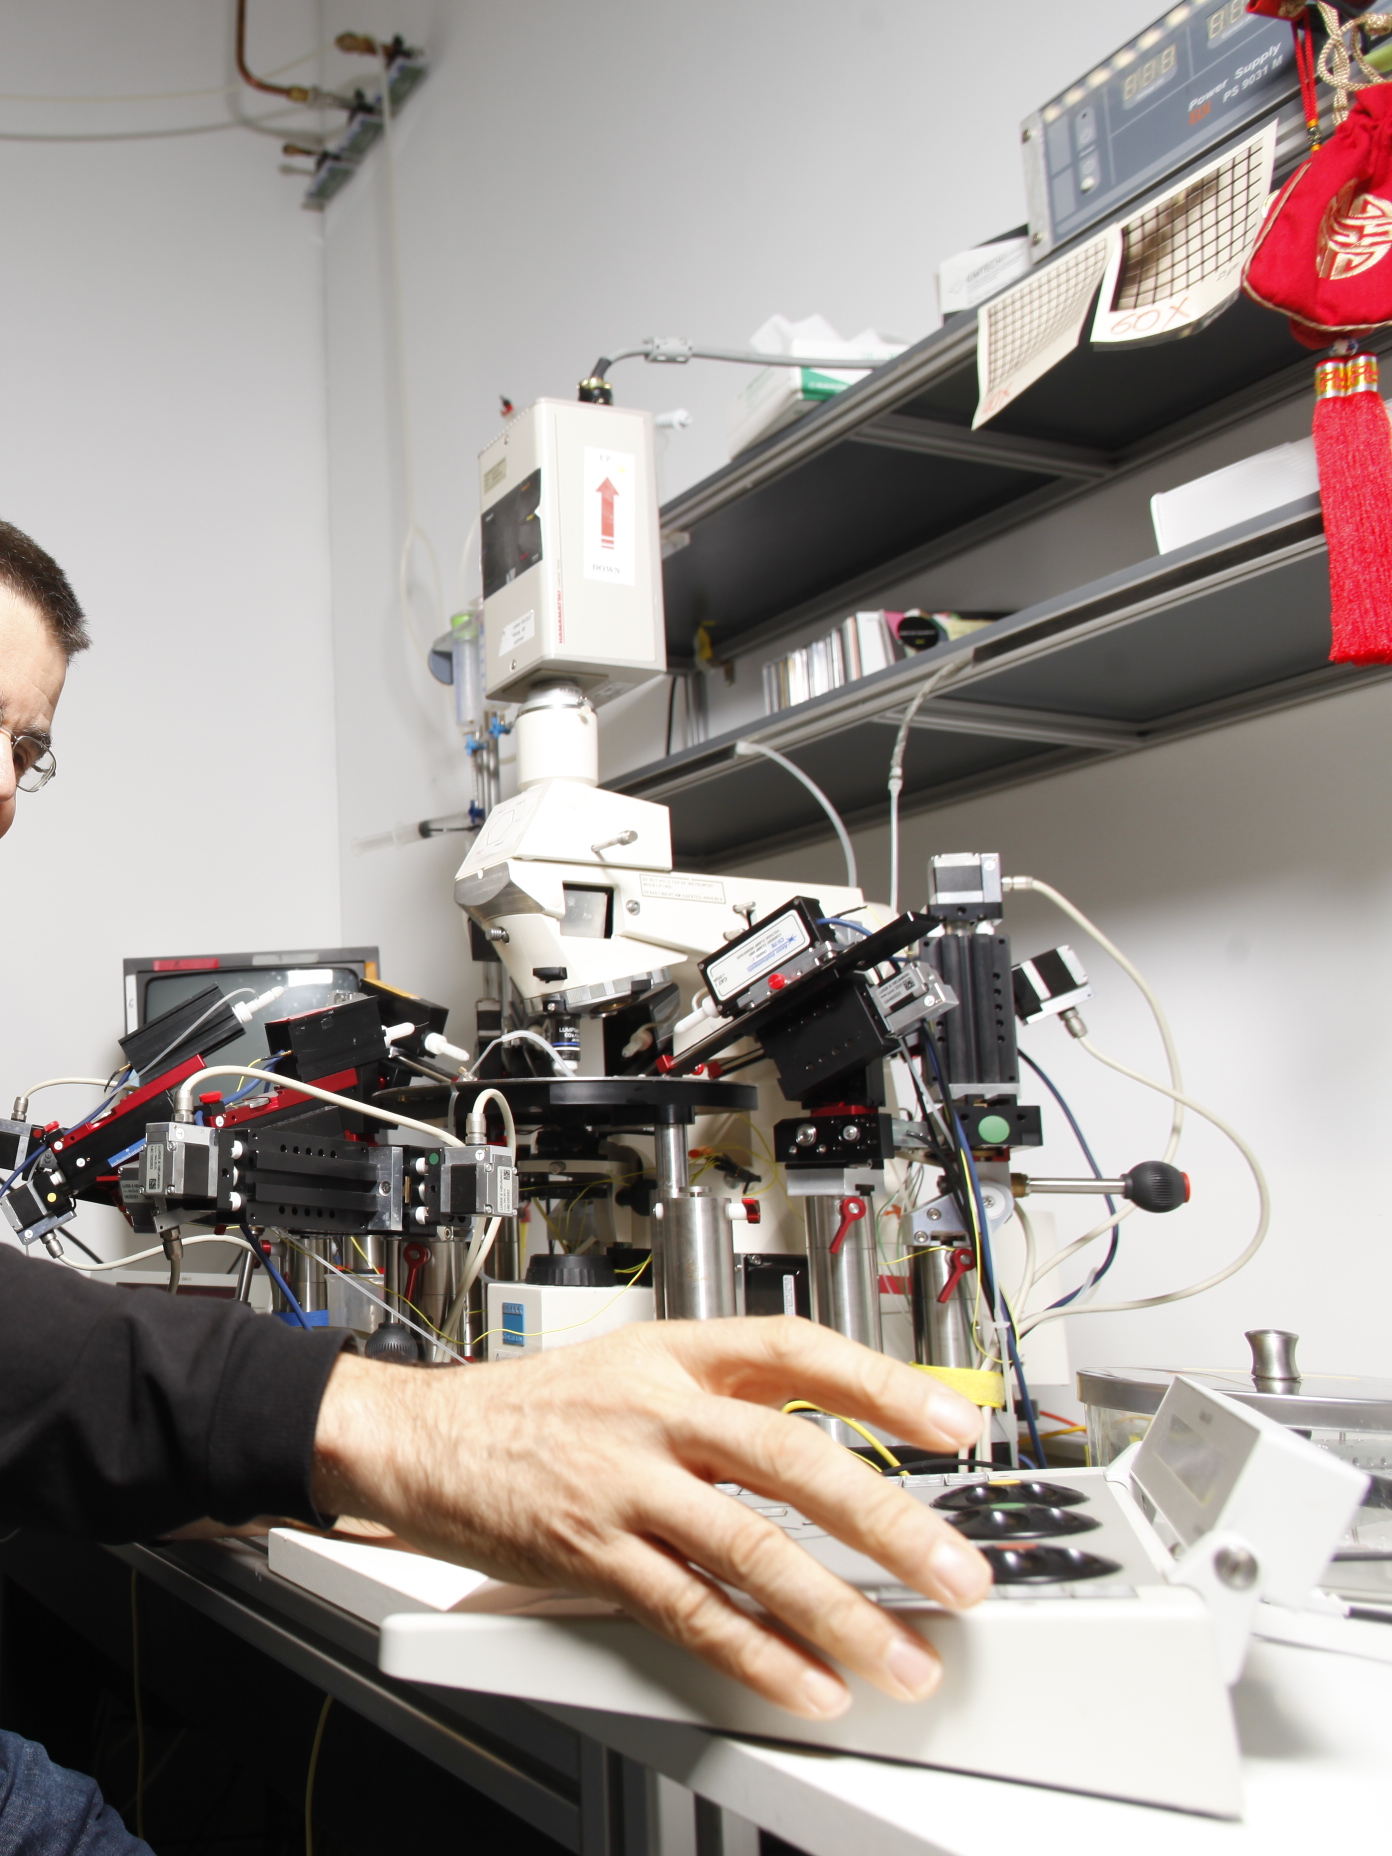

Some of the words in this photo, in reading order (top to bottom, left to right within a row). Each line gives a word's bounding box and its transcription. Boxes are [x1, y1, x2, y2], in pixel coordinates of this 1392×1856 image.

[1188, 79, 1228, 112] Power
[1234, 42, 1281, 80] Supply
[1222, 85, 1239, 103] PS
[1241, 65, 1268, 90] 9031
[1271, 54, 1283, 70] M
[592, 564, 621, 574] DOWN
